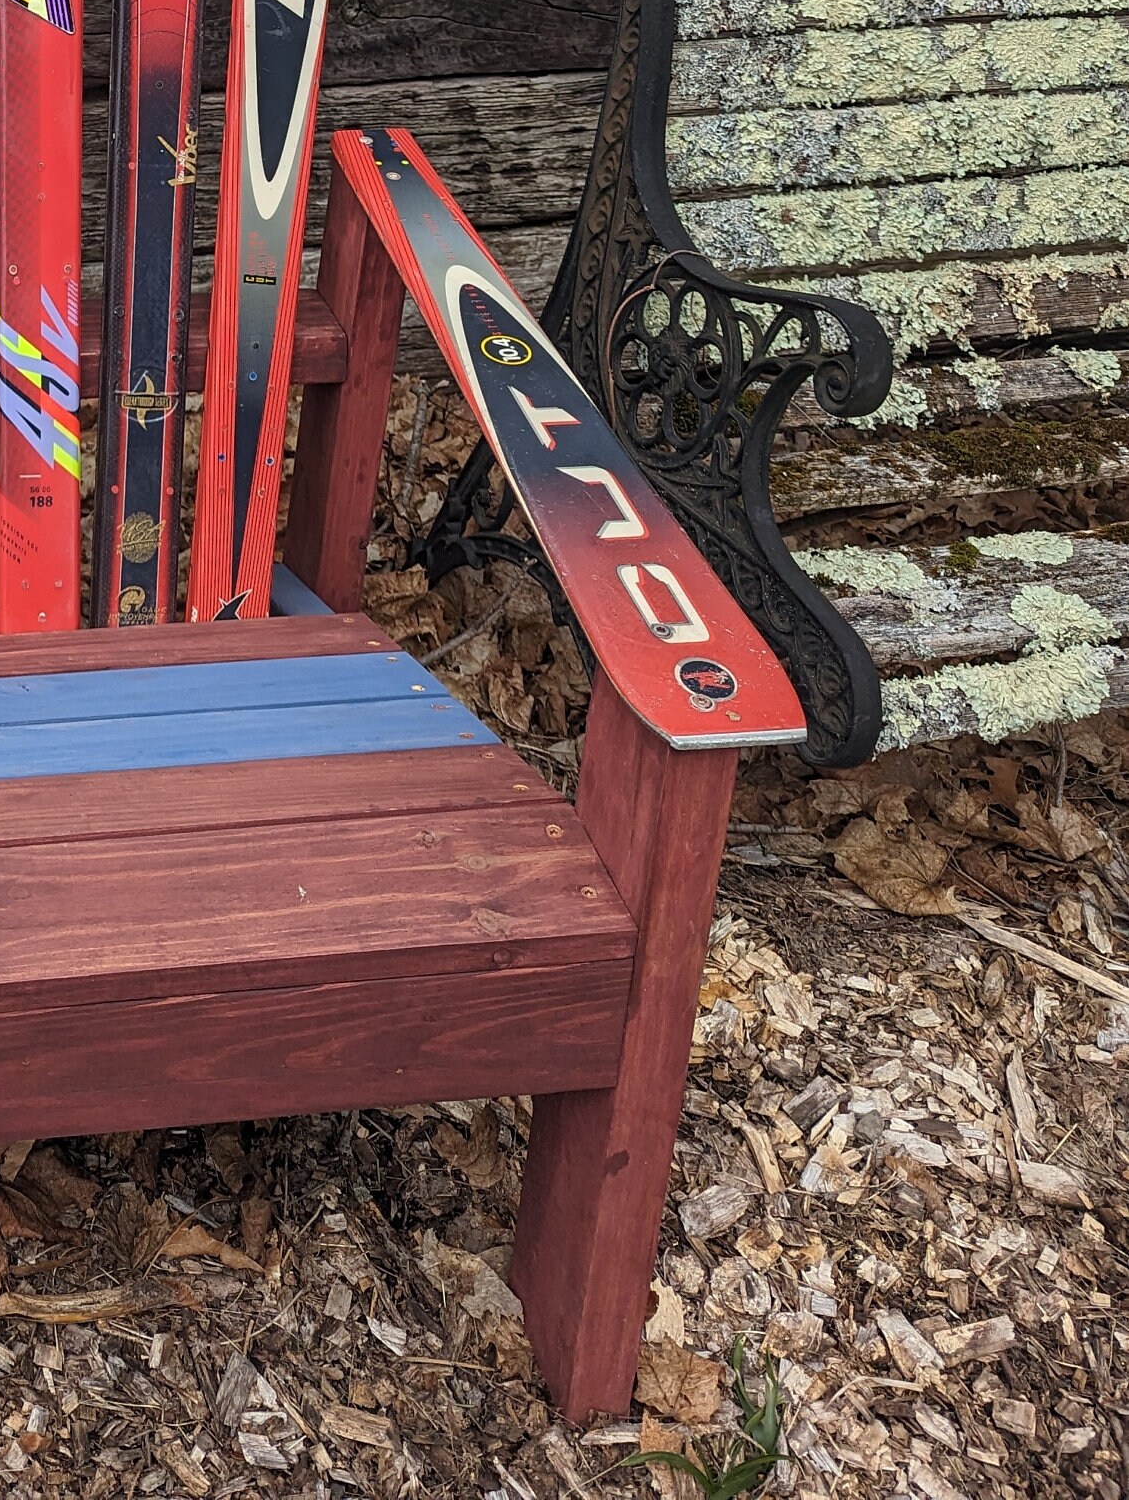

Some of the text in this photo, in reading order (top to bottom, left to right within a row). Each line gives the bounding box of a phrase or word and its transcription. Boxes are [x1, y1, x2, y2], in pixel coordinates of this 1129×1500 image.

[492, 337, 521, 362] 10.4
[30, 495, 53, 507] 188
[506, 384, 711, 644] CUT
